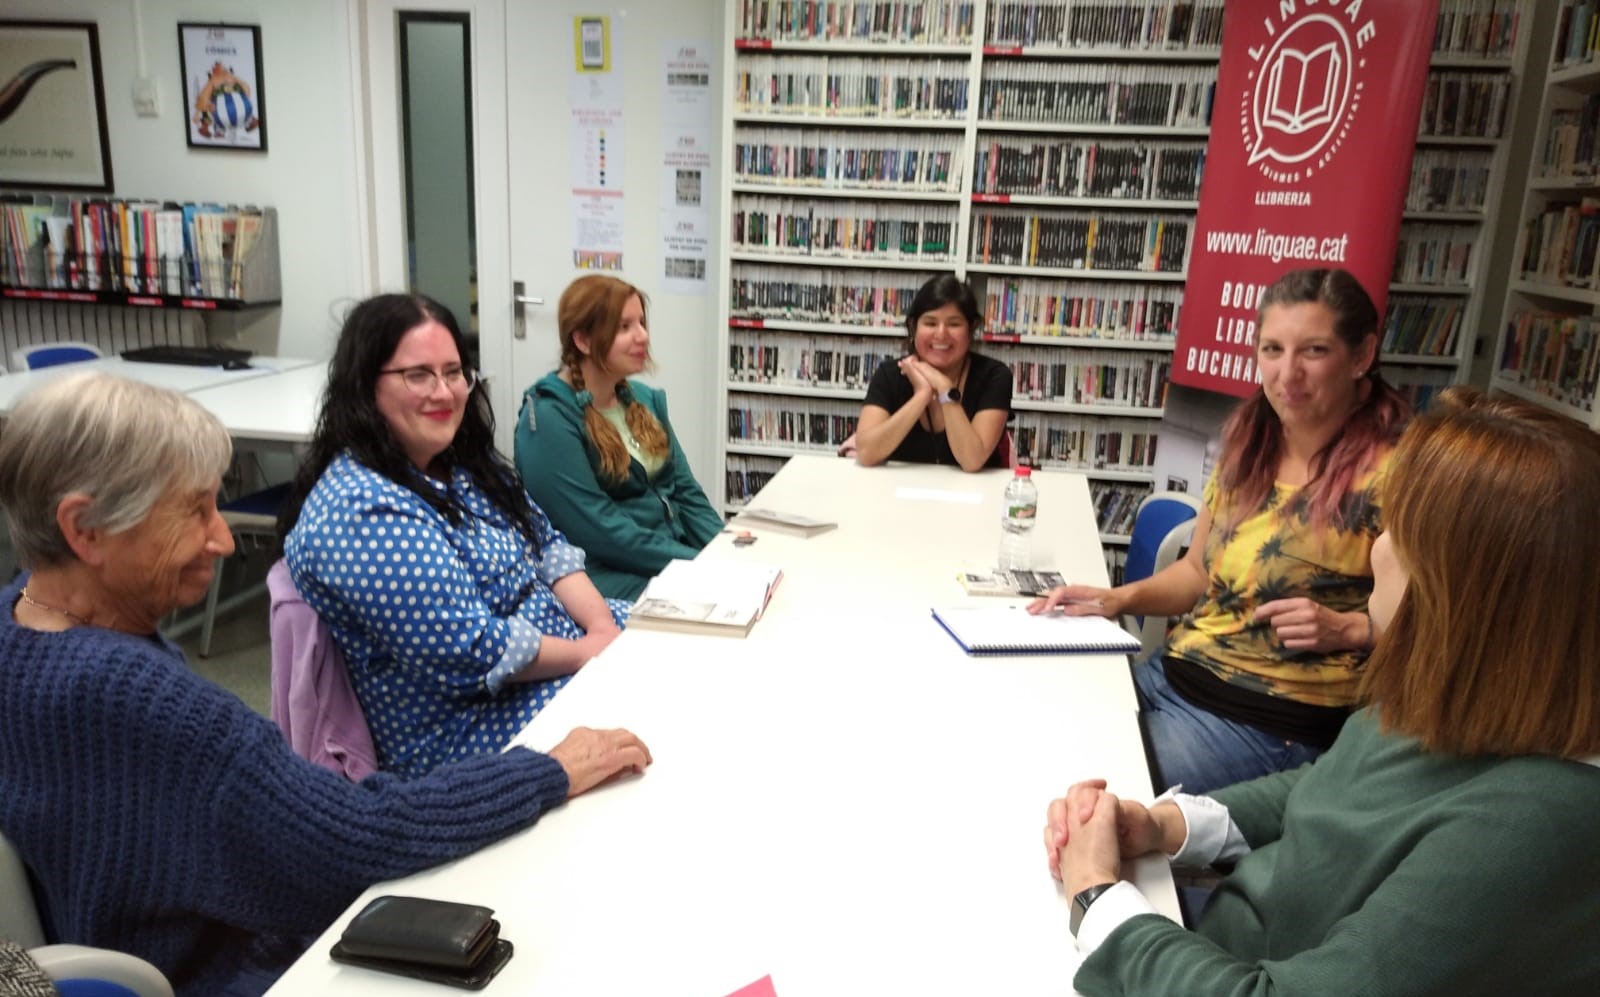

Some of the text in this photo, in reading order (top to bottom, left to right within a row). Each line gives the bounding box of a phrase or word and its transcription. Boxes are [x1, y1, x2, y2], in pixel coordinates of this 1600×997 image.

[1247, 0, 1376, 62] LINAE
[1254, 190, 1311, 206] LLIBRERIA
[1206, 228, 1348, 263] www.linguae.cat
